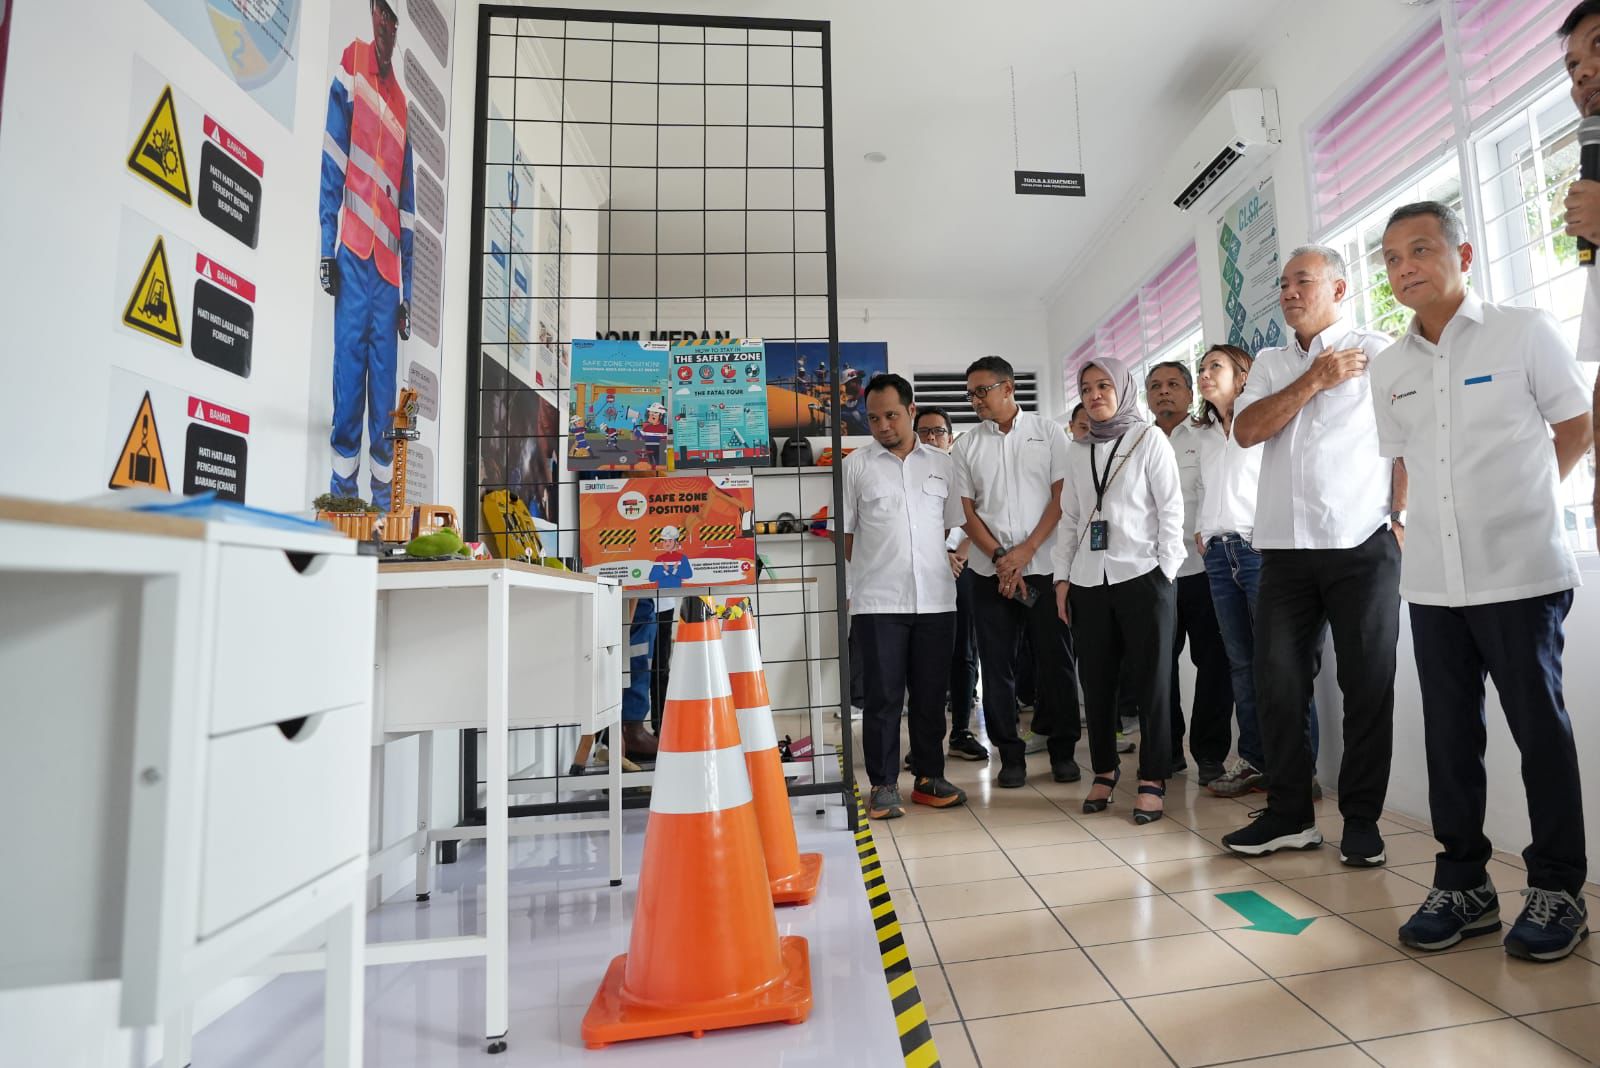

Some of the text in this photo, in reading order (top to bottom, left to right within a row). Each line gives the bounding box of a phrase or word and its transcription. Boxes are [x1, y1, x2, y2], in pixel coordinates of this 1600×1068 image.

[226, 137, 248, 161] BAHAYA
[209, 164, 254, 203] HATI HATI TANGAN
[212, 180, 250, 214] TERJEPIT BENDA
[217, 198, 243, 223] BERPUTAR
[216, 269, 238, 289] BAHAYA
[197, 306, 249, 340] HATI HATI LALU LINTAS
[212, 328, 235, 347] FORKLIFT
[675, 352, 761, 364] THE SAFETY ZONE
[209, 408, 231, 425] BAHAYA
[198, 446, 236, 465] HATI HATI AREA
[196, 461, 237, 479] PENGANGKATAN
[194, 475, 237, 495] BARANG (CRANE)
[648, 492, 708, 503] SAFE ZONE
